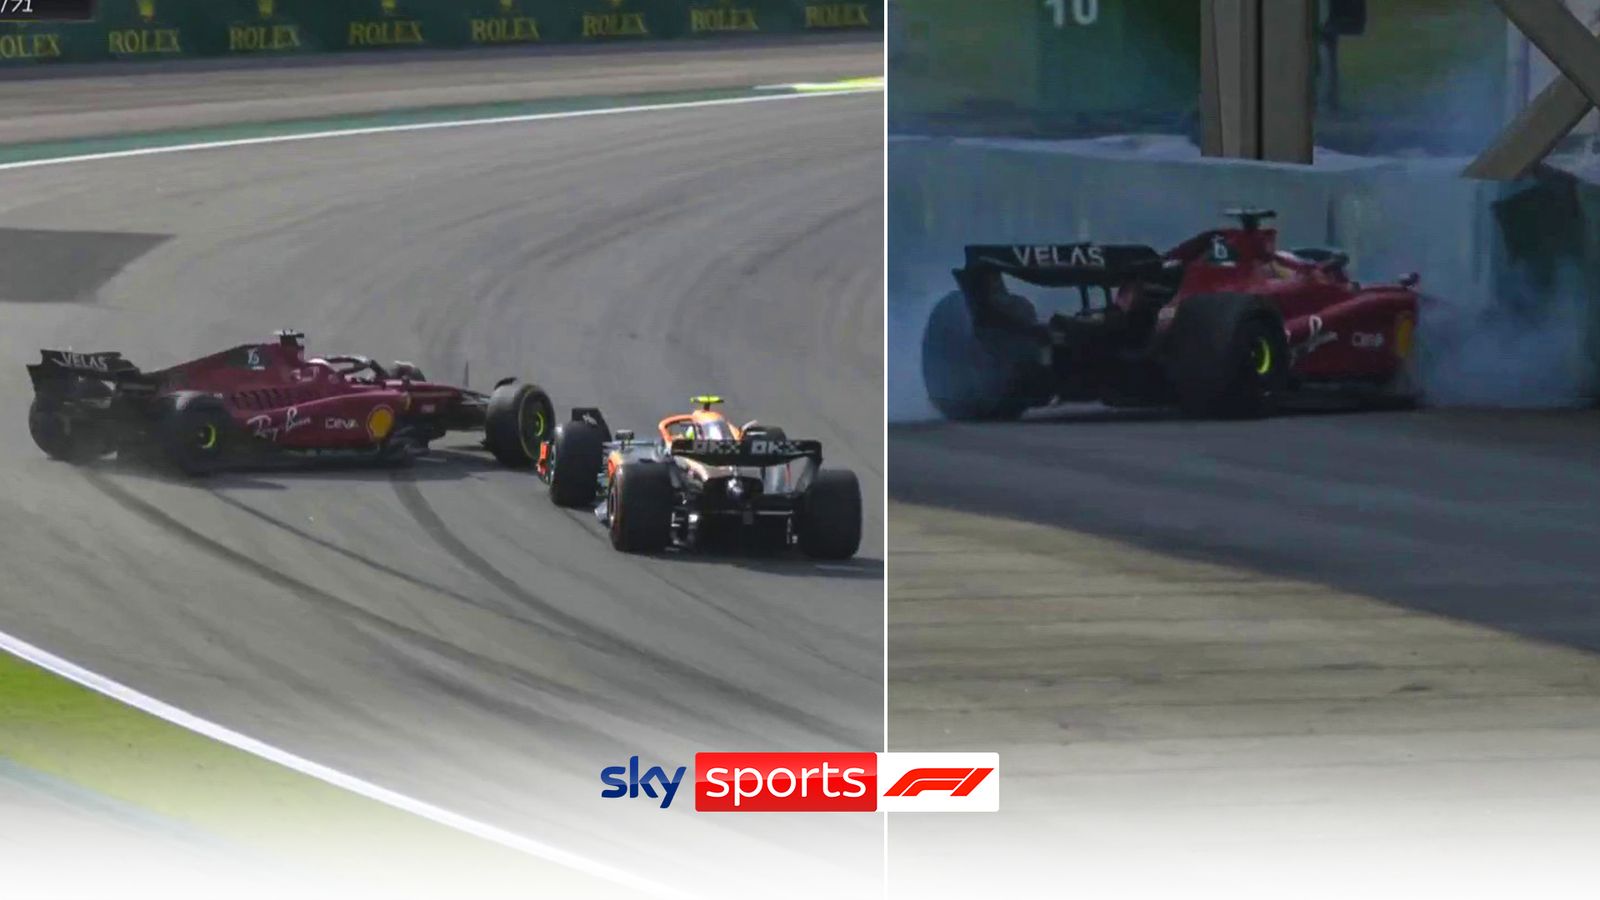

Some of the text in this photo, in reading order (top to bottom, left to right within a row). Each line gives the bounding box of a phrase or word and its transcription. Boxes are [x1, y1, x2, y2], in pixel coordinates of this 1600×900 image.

[1046, 0, 1099, 28] 10
[0, 33, 61, 58] OLEX
[108, 29, 181, 53] ROLEX
[229, 26, 300, 50] ROLEX
[350, 21, 424, 45] ROLEX
[471, 17, 541, 42] ROLEX
[1012, 246, 1105, 266] VELAS
[62, 352, 108, 371] VELAS
